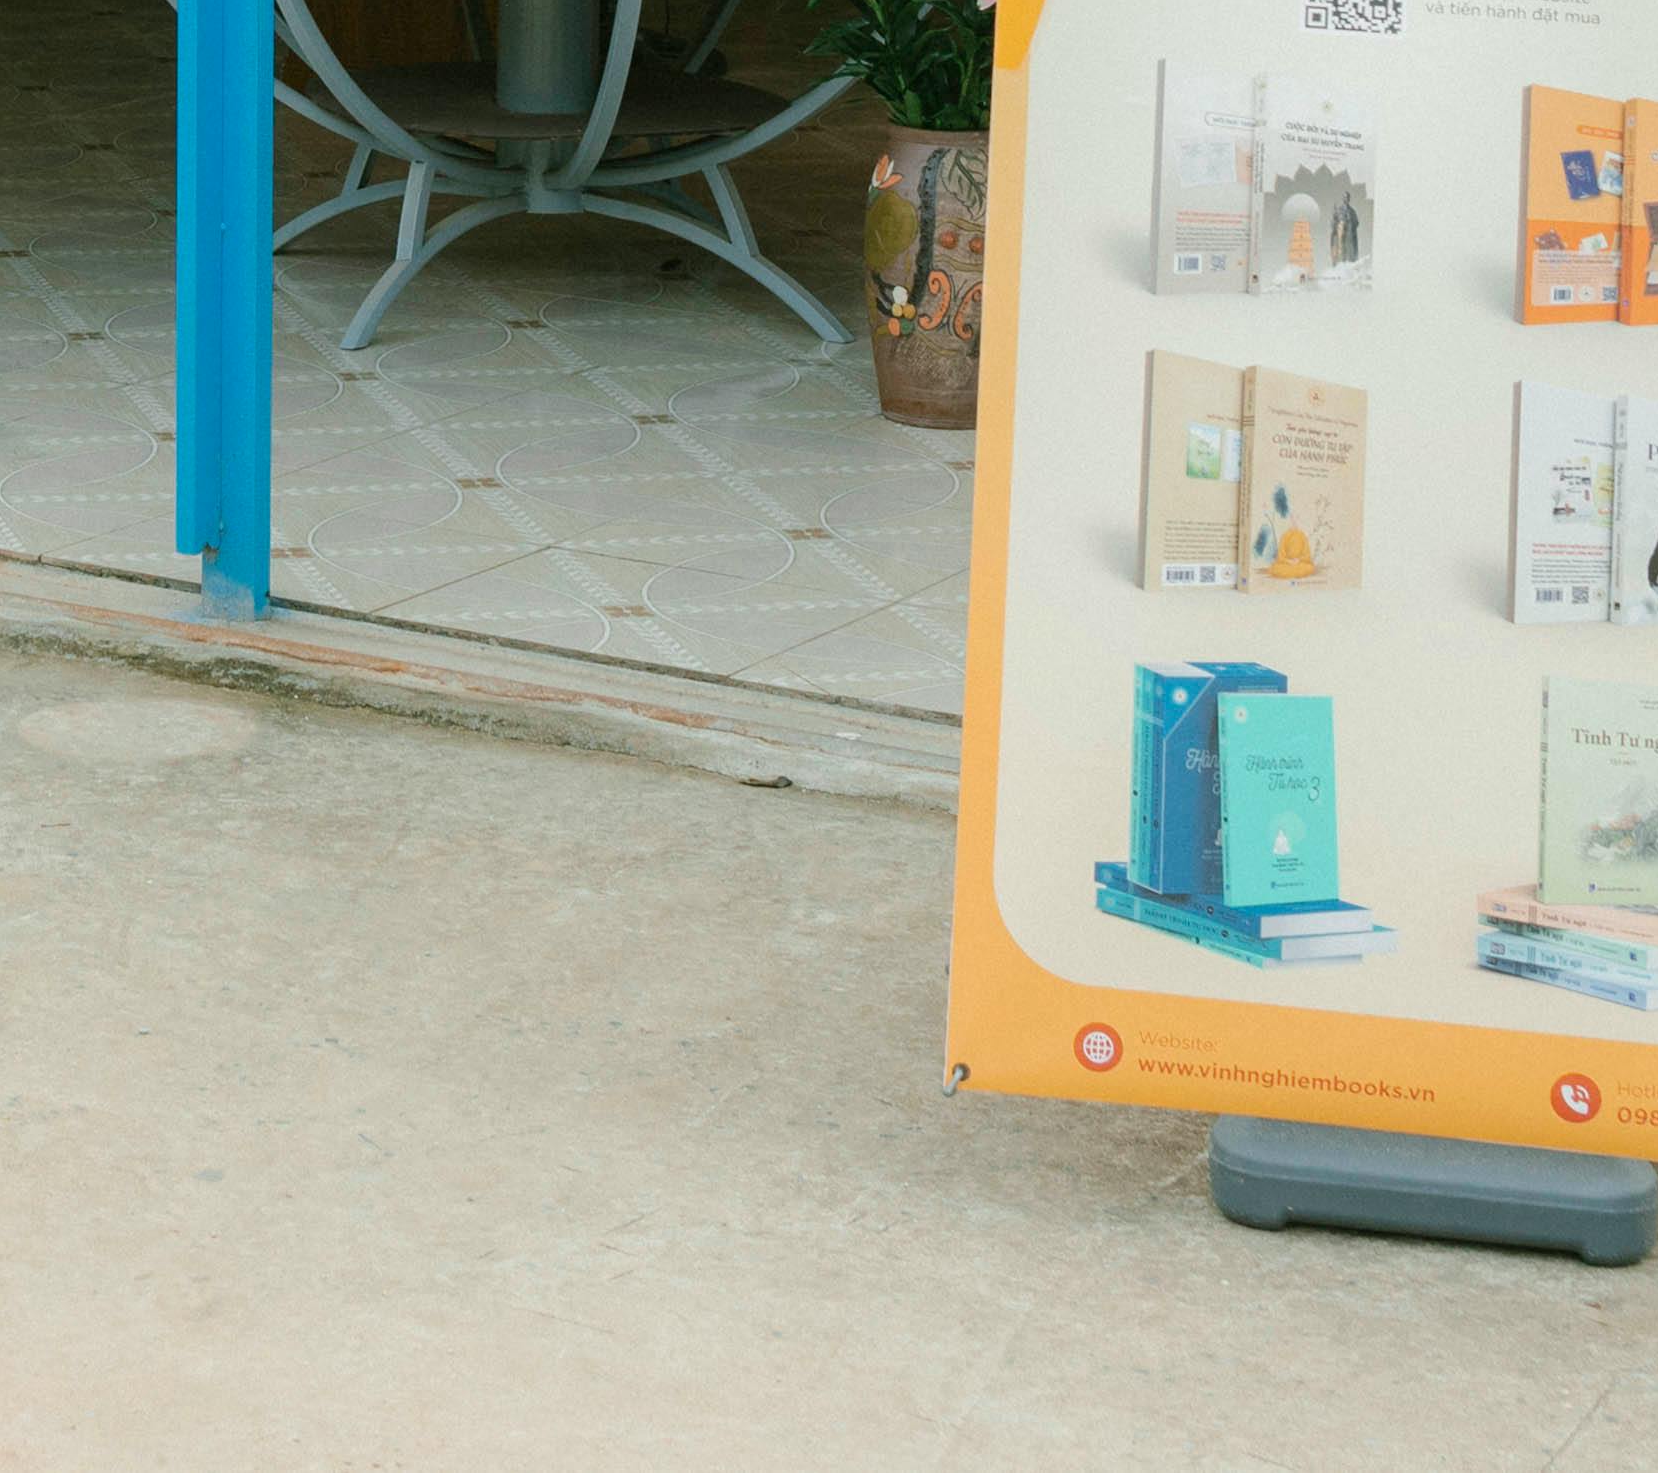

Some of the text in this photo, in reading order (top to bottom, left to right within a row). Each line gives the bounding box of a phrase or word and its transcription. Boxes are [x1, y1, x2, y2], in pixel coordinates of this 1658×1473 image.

[1426, 0, 1602, 25] và tiến hành đặt mua
[1139, 1030, 1219, 1053] Website:
[1138, 1056, 1436, 1103] www.vinhnghiembooks.vn
